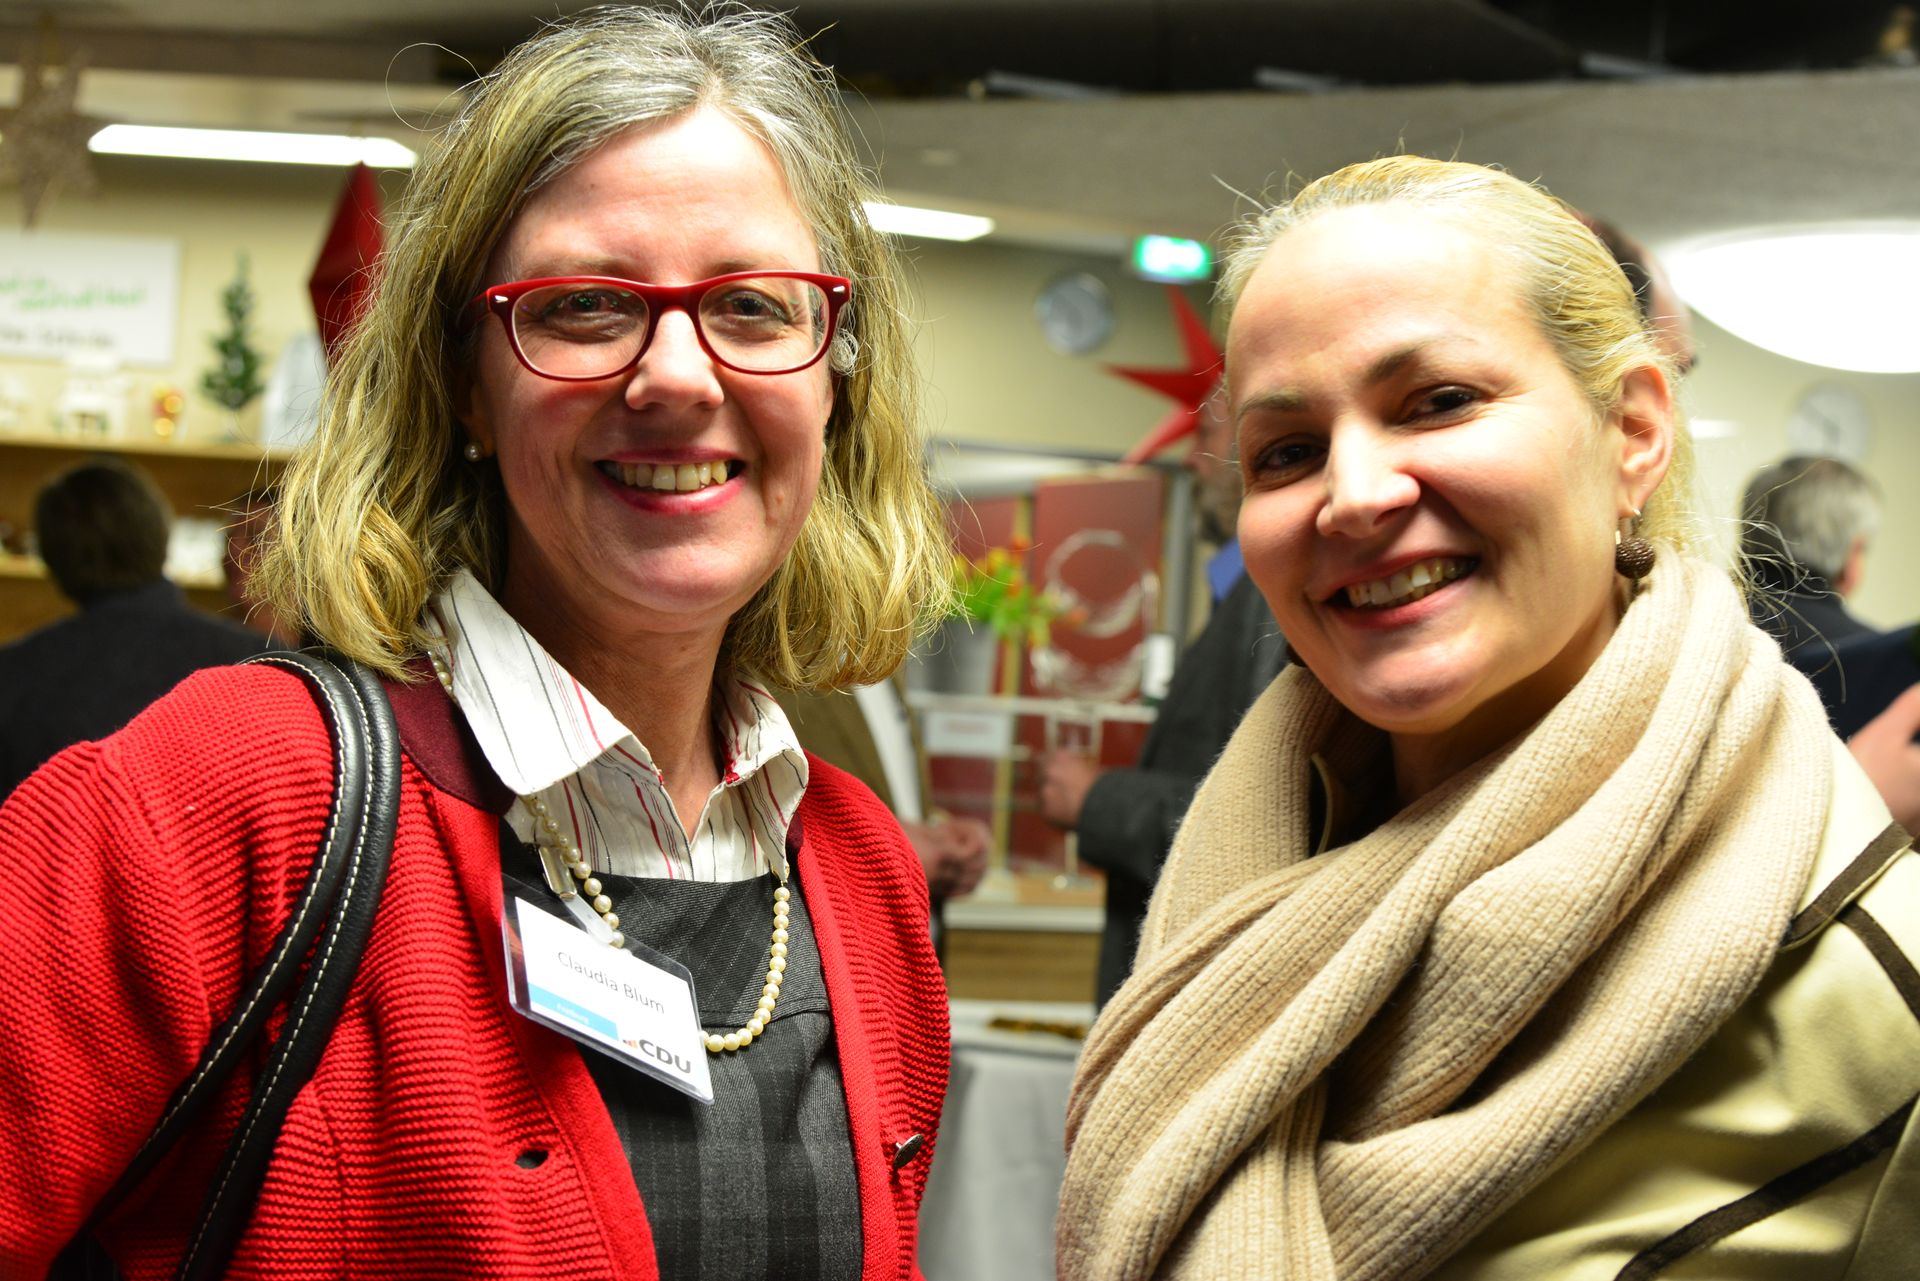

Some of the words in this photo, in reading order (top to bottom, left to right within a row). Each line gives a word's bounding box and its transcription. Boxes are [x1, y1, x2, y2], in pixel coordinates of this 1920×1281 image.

[557, 951, 619, 992] Claudia
[622, 983, 666, 1014] Blum
[638, 1038, 692, 1074] CDU
